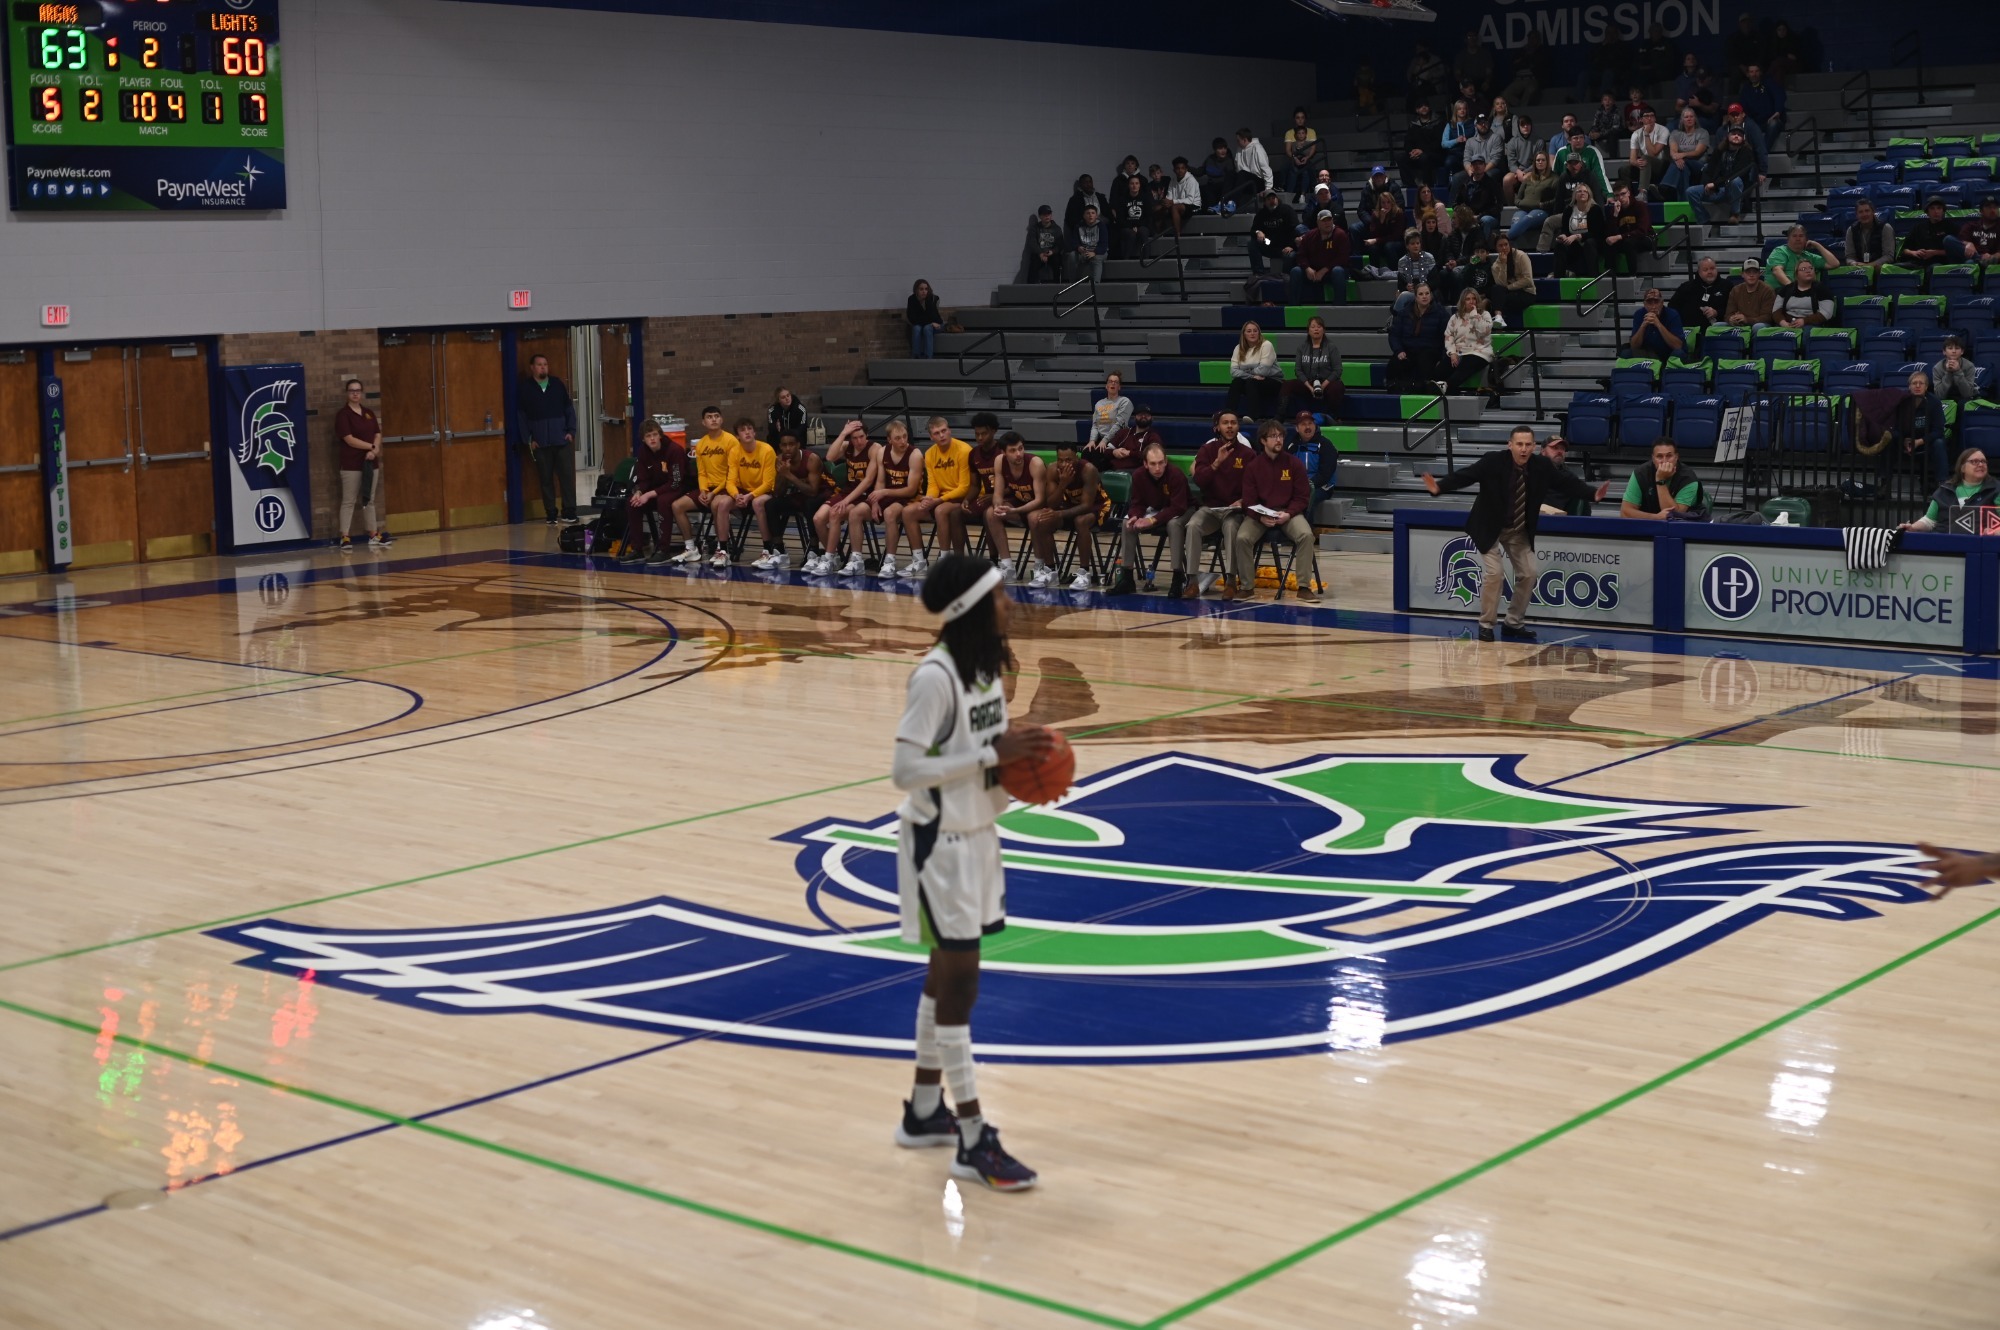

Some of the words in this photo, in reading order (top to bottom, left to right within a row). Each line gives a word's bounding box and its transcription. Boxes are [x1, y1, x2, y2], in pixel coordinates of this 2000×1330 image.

[132, 20, 168, 32] PERIOD
[211, 13, 259, 32] LIGHTS
[1477, 0, 1721, 50] ADMISSION
[41, 28, 87, 69] 63
[143, 37, 159, 68] 2
[223, 37, 265, 75] 60
[30, 74, 61, 85] FOULS
[78, 76, 104, 86] T.O.L.
[119, 77, 151, 88] PLAYER
[160, 79, 184, 89] FOUL
[200, 80, 224, 90] T.O.L.
[239, 81, 267, 91] FOULS
[42, 87, 61, 122] 5
[84, 89, 100, 121] 2
[167, 95, 184, 120] 4
[214, 96, 221, 121] 1
[251, 94, 266, 122] 7
[32, 124, 63, 134] SCORE
[139, 126, 169, 136] MATCH
[241, 128, 268, 137] SCORE
[27, 166, 112, 179] PayneWest.com
[157, 178, 247, 201] PayneWest
[201, 199, 247, 207] INSURANCE
[514, 291, 529, 307] EXIT
[47, 306, 67, 324] EXIT
[51, 408, 69, 551] ATHLETICS
[1537, 550, 1552, 562] OF
[1553, 551, 1620, 575] PROVIDENCE
[1501, 569, 1620, 612] GOS
[1772, 566, 1913, 590] UNIVERSITY
[1922, 574, 1953, 593] OF
[1772, 588, 1953, 624] PROVIDENCE
